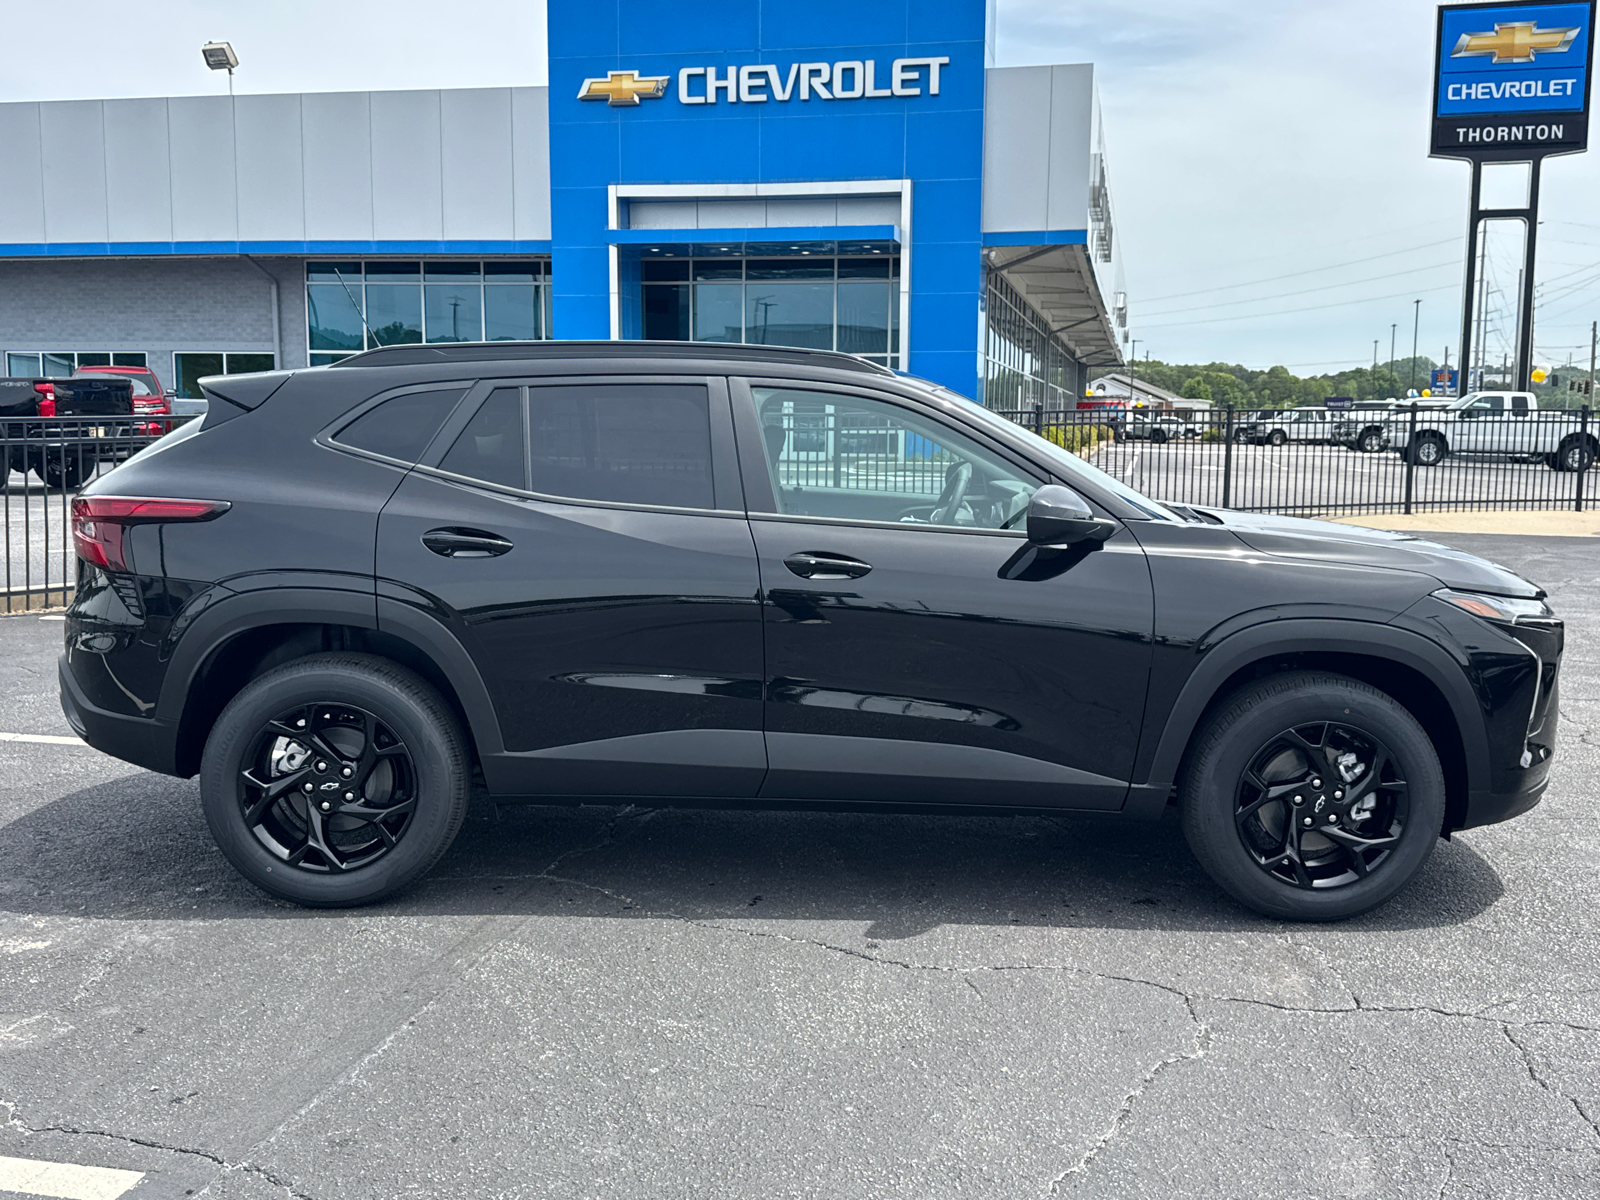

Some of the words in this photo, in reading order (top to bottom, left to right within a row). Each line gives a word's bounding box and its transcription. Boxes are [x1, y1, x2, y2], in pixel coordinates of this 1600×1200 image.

[678, 56, 950, 104] CHEVROLET
[1447, 79, 1577, 100] CHEVROLET
[1456, 124, 1564, 143] THORNTON
